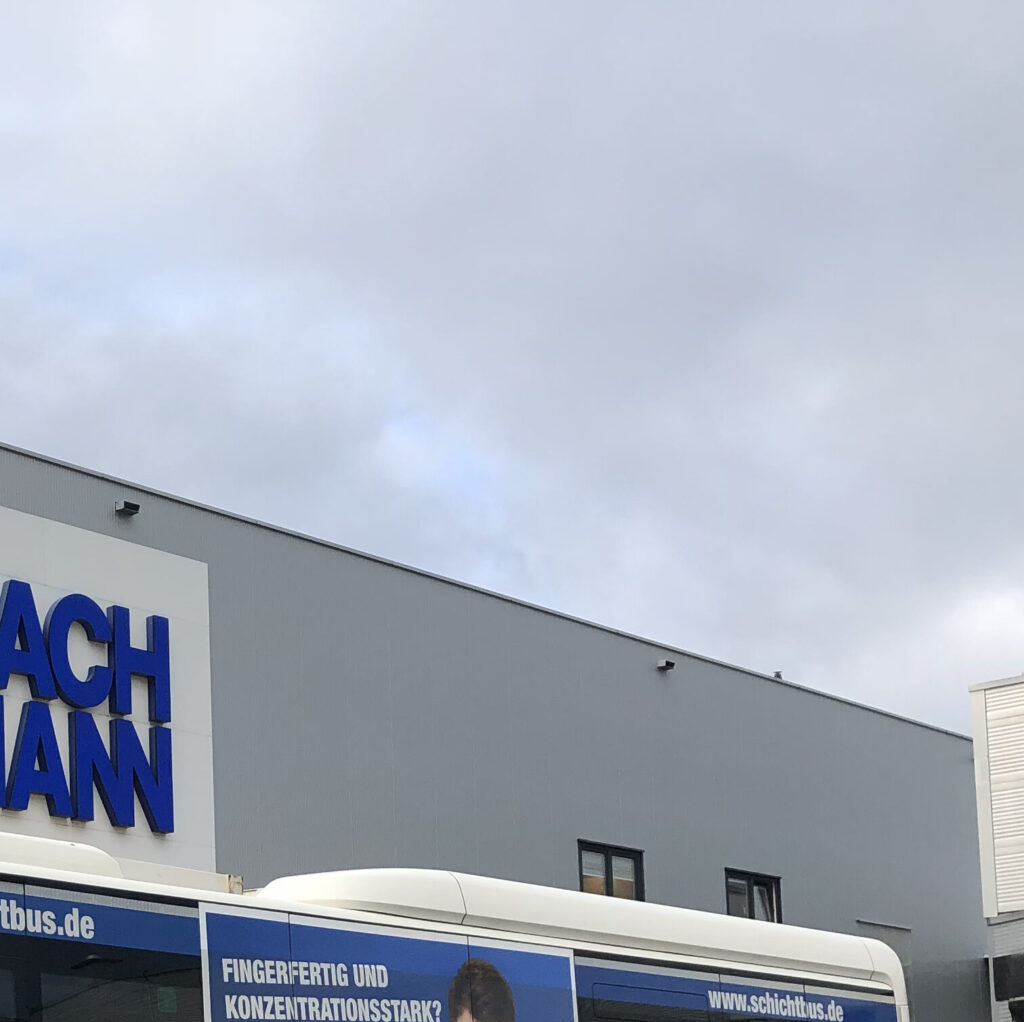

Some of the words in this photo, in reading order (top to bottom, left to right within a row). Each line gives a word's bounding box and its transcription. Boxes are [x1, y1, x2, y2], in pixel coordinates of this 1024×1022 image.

[222, 958, 349, 987] FINGERFERTIG
[353, 964, 389, 988] UND
[225, 994, 442, 1022] KONZENTRATIONSSTARK?
[708, 989, 844, 1022] www.schichtbus.de
